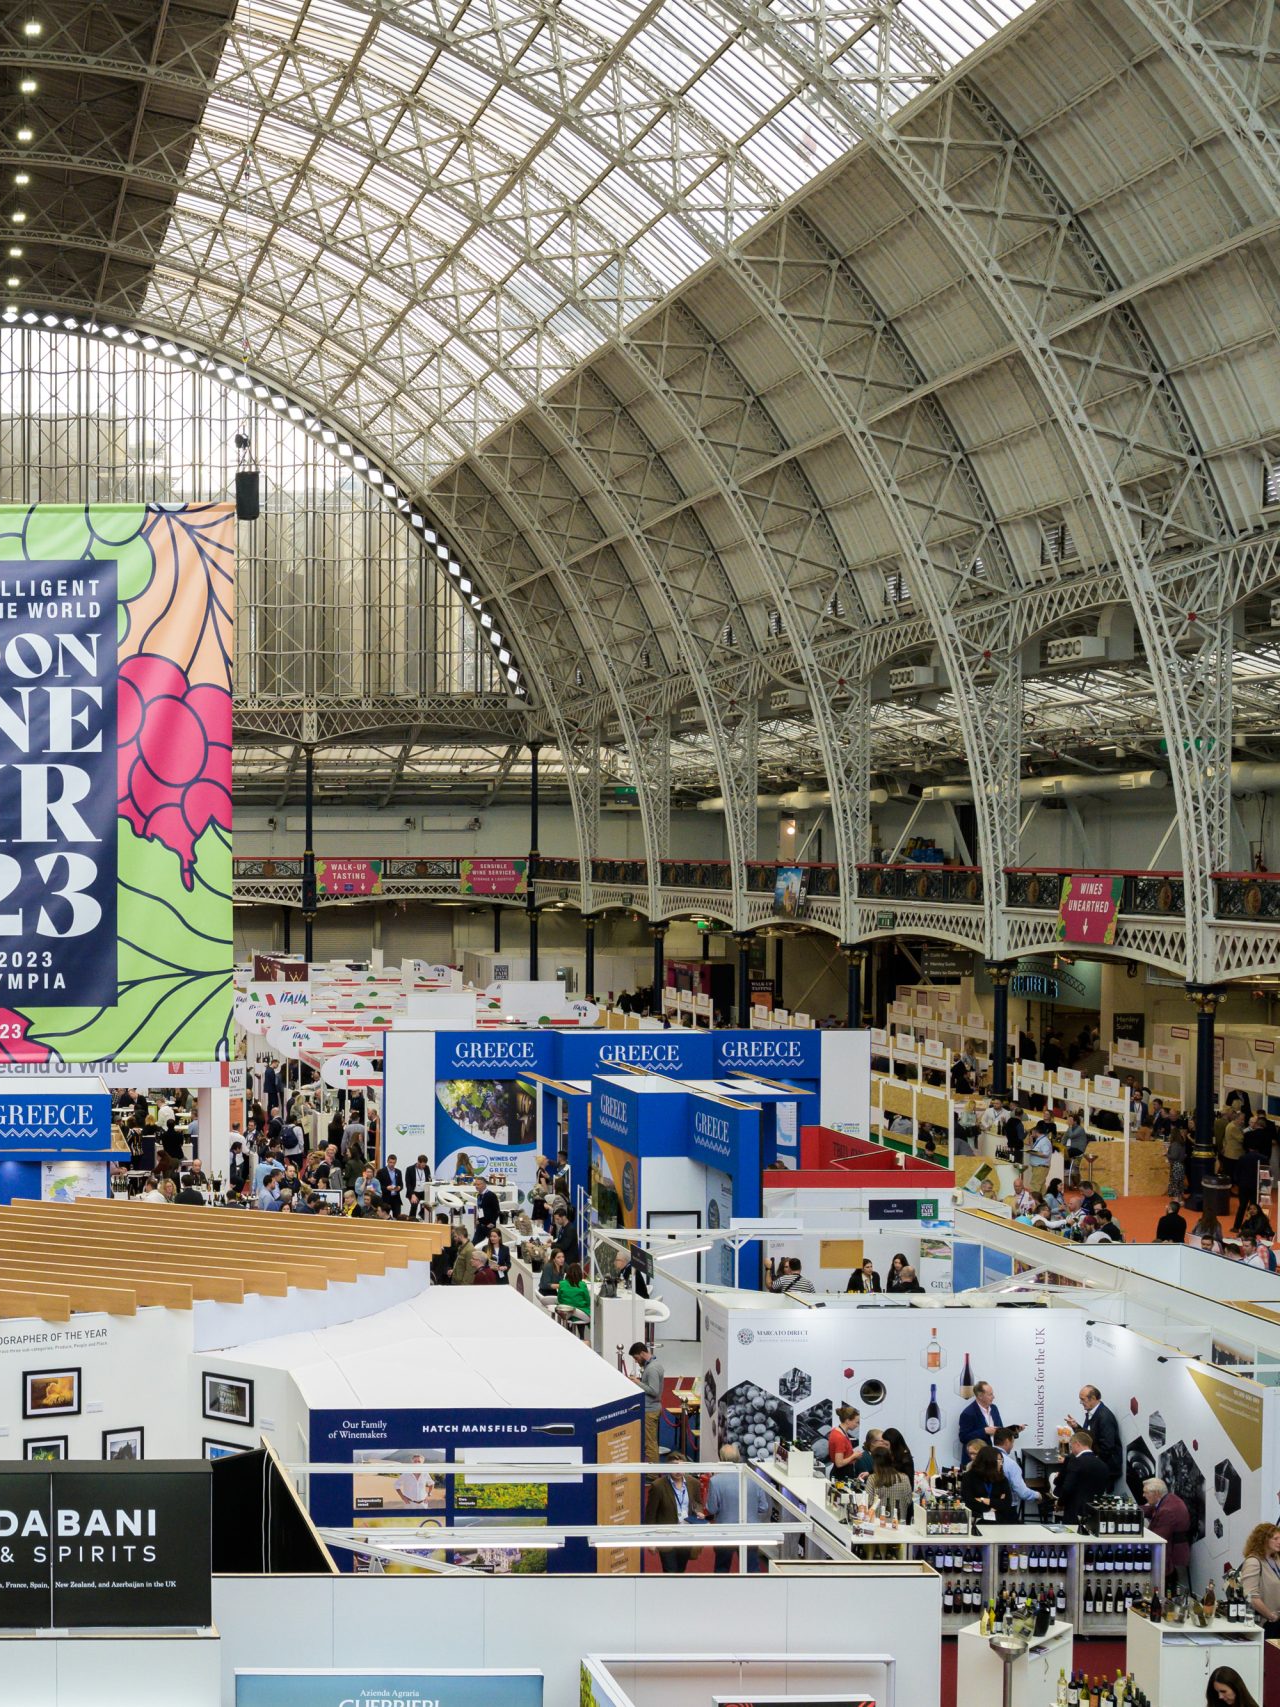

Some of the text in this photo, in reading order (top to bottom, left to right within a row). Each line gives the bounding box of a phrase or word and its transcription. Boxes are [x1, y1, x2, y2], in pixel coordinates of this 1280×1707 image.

[27, 601, 101, 619] WORLD
[330, 863, 367, 871] WALK-UP
[332, 872, 366, 880] TASTING
[1080, 882, 1104, 895] WINES
[1068, 899, 1109, 913] UNEARTHED
[279, 991, 309, 1006] ITALIA
[455, 1042, 534, 1059] GREECE
[599, 1045, 680, 1061] GREECE
[722, 1041, 801, 1057] GREECE
[339, 1058, 360, 1068] ITALIA
[600, 1093, 627, 1123] GREECE
[694, 1111, 730, 1143] GREECE
[50, 1332, 62, 1342] OF
[64, 1331, 82, 1341] THE
[84, 1328, 107, 1339] YEAR
[1034, 1328, 1046, 1447] winemakers for the UK
[342, 1420, 387, 1432] Our Family
[422, 1424, 528, 1433] HATCH MANSFIELD
[328, 1430, 387, 1439] of Winemakers
[0, 1546, 15, 1563] &
[33, 1545, 157, 1563] SPIRITS
[5, 1581, 29, 1590] France,
[29, 1581, 50, 1590] Spain,
[70, 1581, 97, 1590] Zealand,
[111, 1581, 145, 1590] Azerbaijan
[145, 1580, 153, 1588] in
[165, 1580, 177, 1588] UK
[359, 1689, 420, 1699] Azienda Agraria
